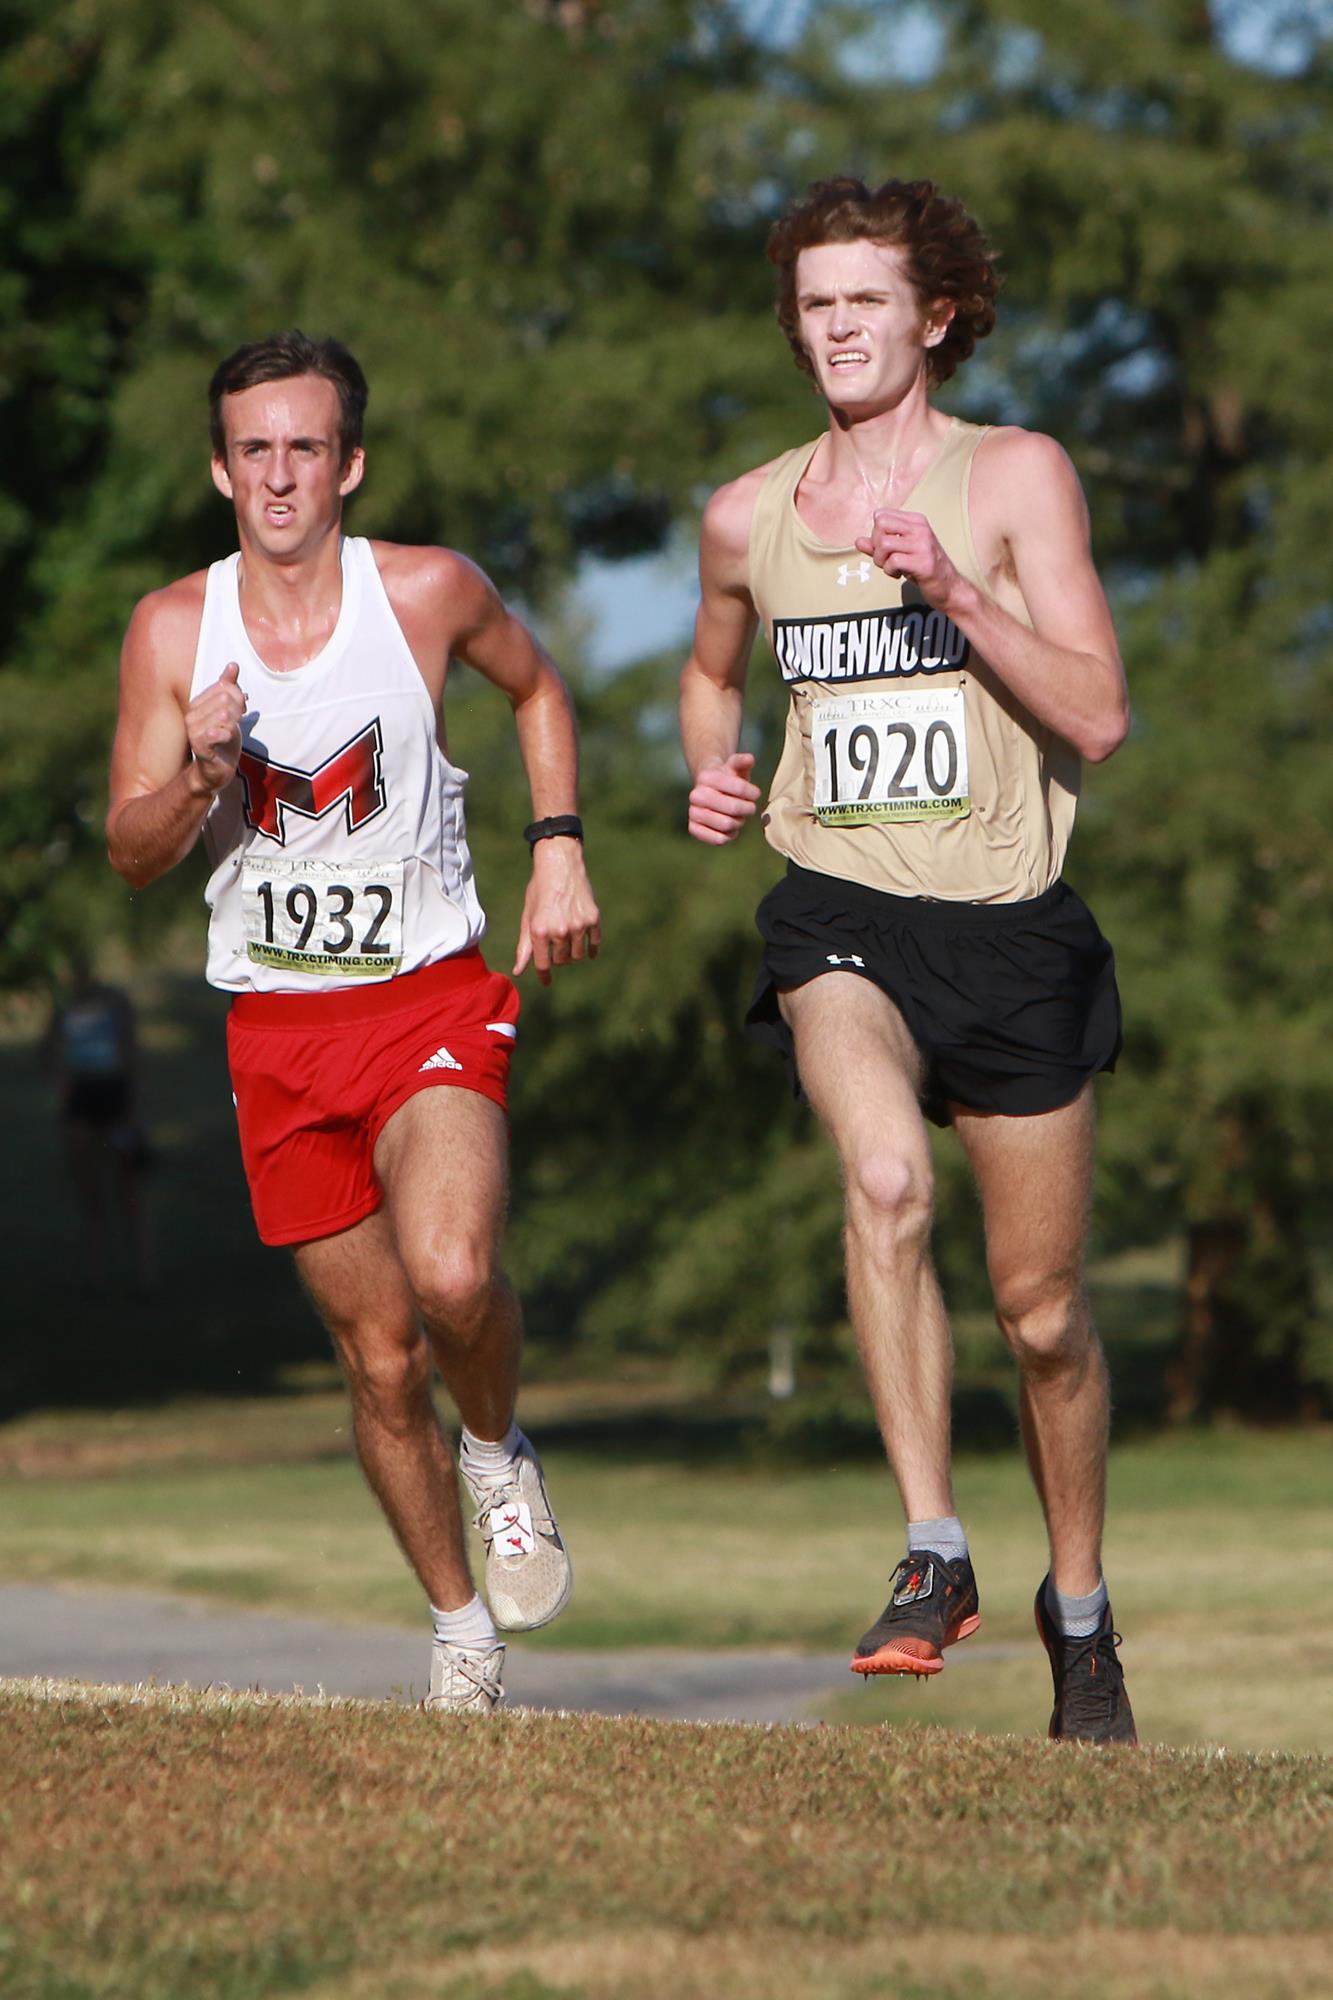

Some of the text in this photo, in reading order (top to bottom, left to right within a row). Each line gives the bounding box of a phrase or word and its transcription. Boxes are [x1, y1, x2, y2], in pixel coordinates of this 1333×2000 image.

[848, 695, 912, 712] TRXC
[824, 720, 958, 803] 1920
[817, 798, 962, 815] WWW.TRXCTIMING.COM
[257, 881, 393, 954] 1932
[251, 943, 394, 966] WWW.TRXCTIMING.COM
